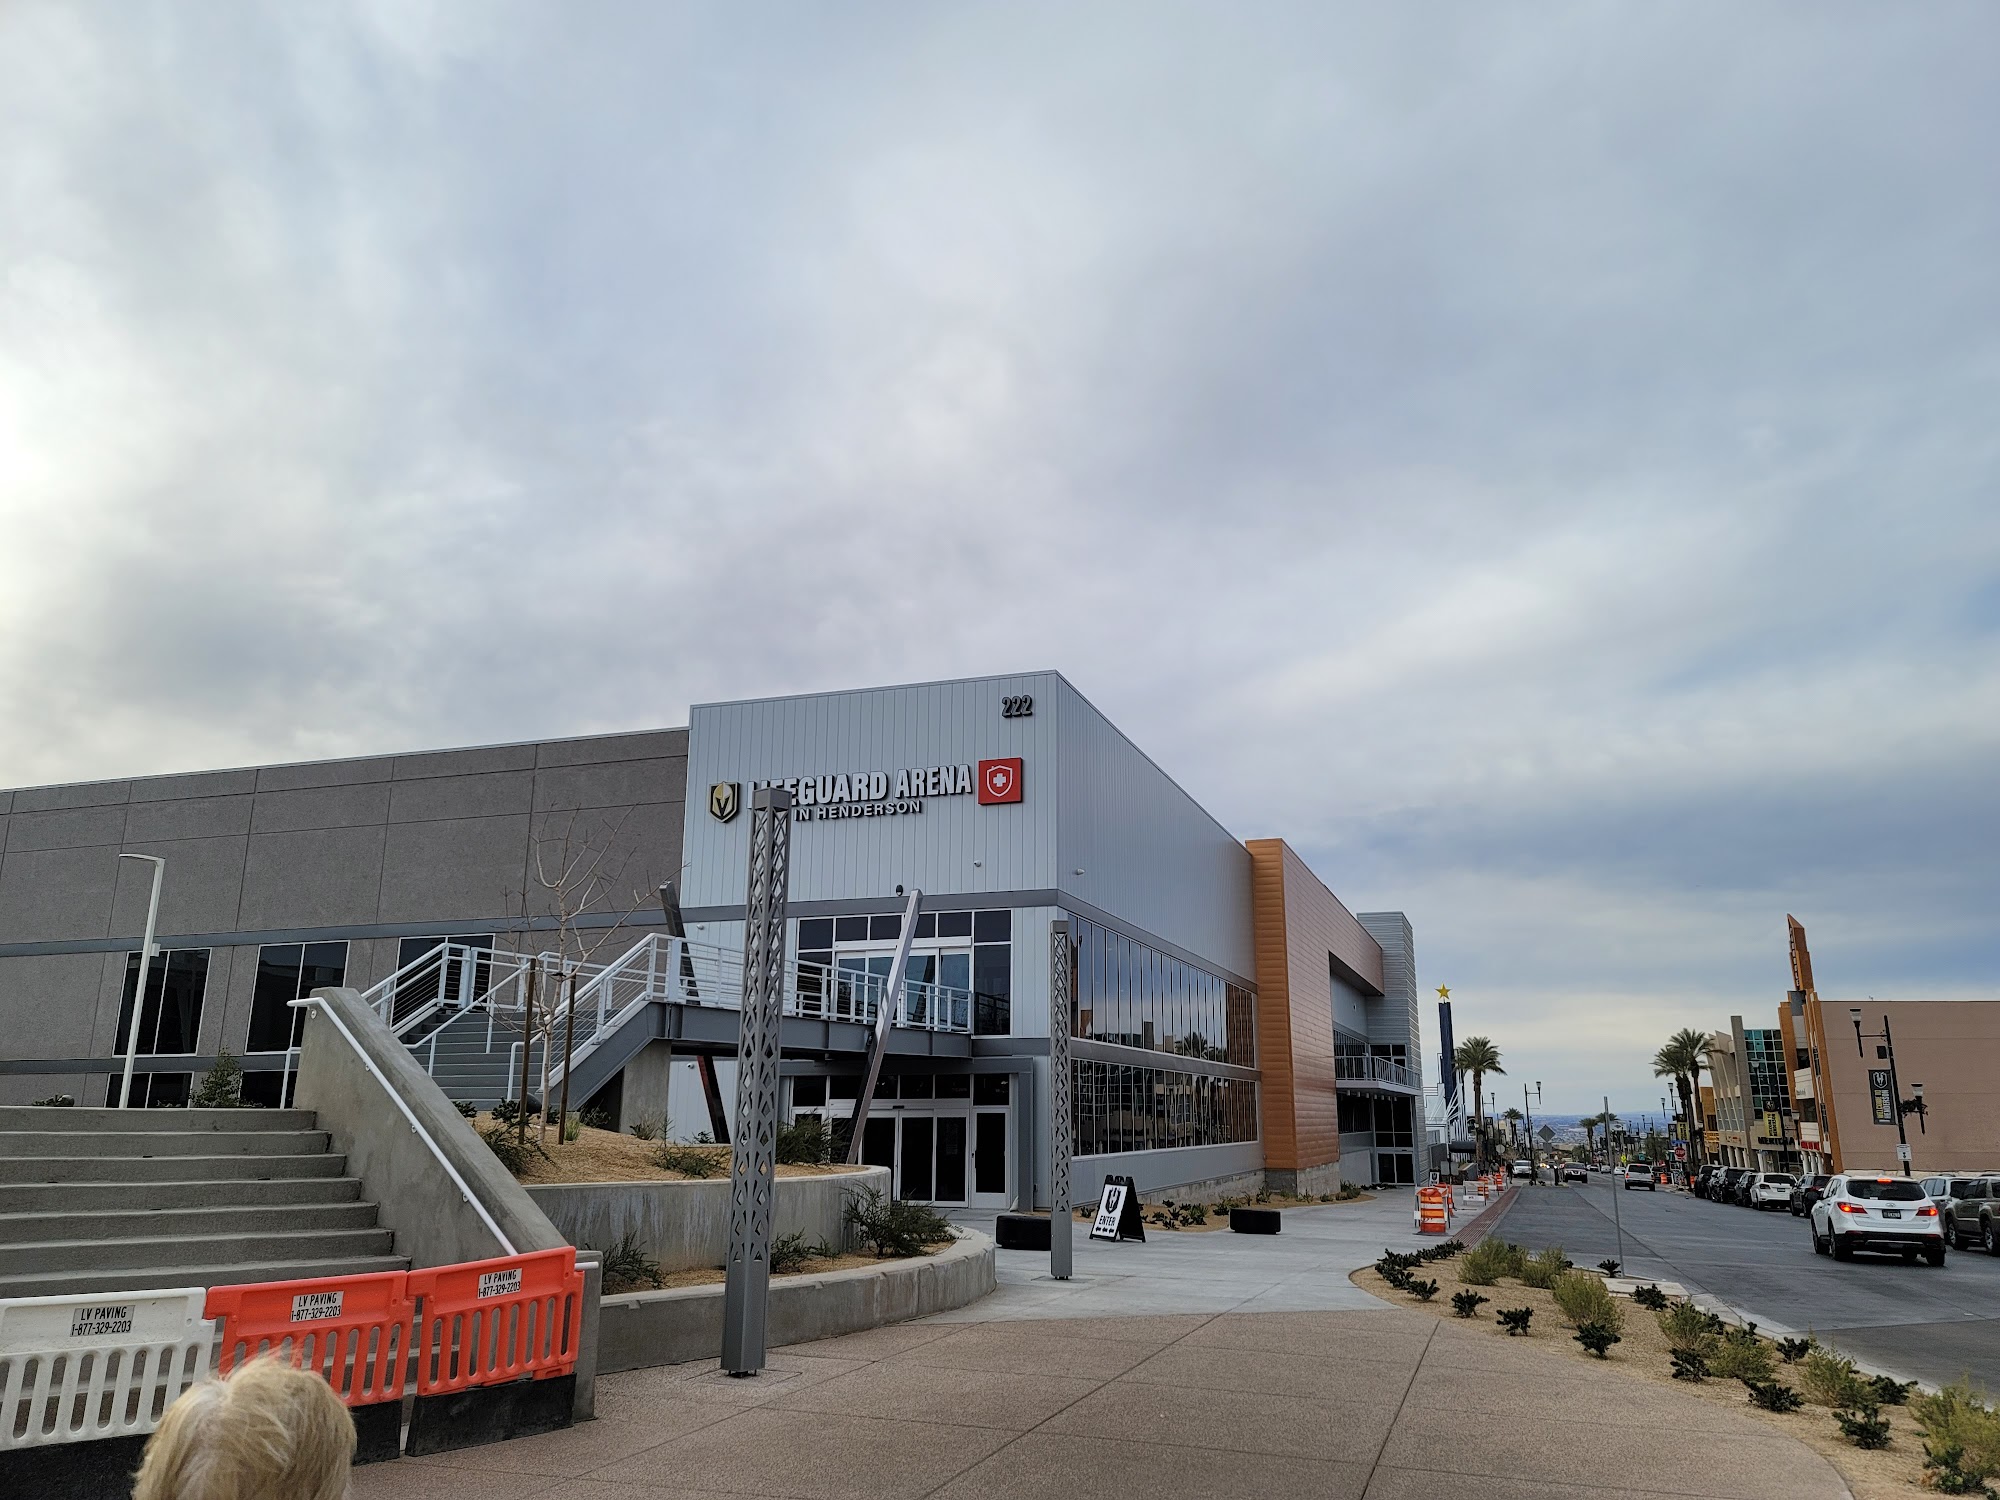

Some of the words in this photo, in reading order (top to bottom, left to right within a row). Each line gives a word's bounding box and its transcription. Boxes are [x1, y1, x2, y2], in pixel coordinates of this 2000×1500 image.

[1002, 695, 1032, 718] 222
[747, 770, 888, 809] LEGUARD
[895, 764, 973, 799] ARENA
[793, 808, 811, 821] IN
[817, 800, 922, 820] HENDERSON
[1099, 1215, 1116, 1226] ENTER
[484, 1274, 493, 1285] LV
[493, 1269, 517, 1283] PAVING
[478, 1281, 521, 1298] 1-877-329-2203
[298, 1295, 308, 1307] LV
[309, 1292, 337, 1306] PAVING
[81, 1308, 93, 1320] LV
[94, 1306, 127, 1320] PAVING
[291, 1305, 341, 1321] 1-877-329-2203
[71, 1320, 132, 1336] 1-877-329-2203
